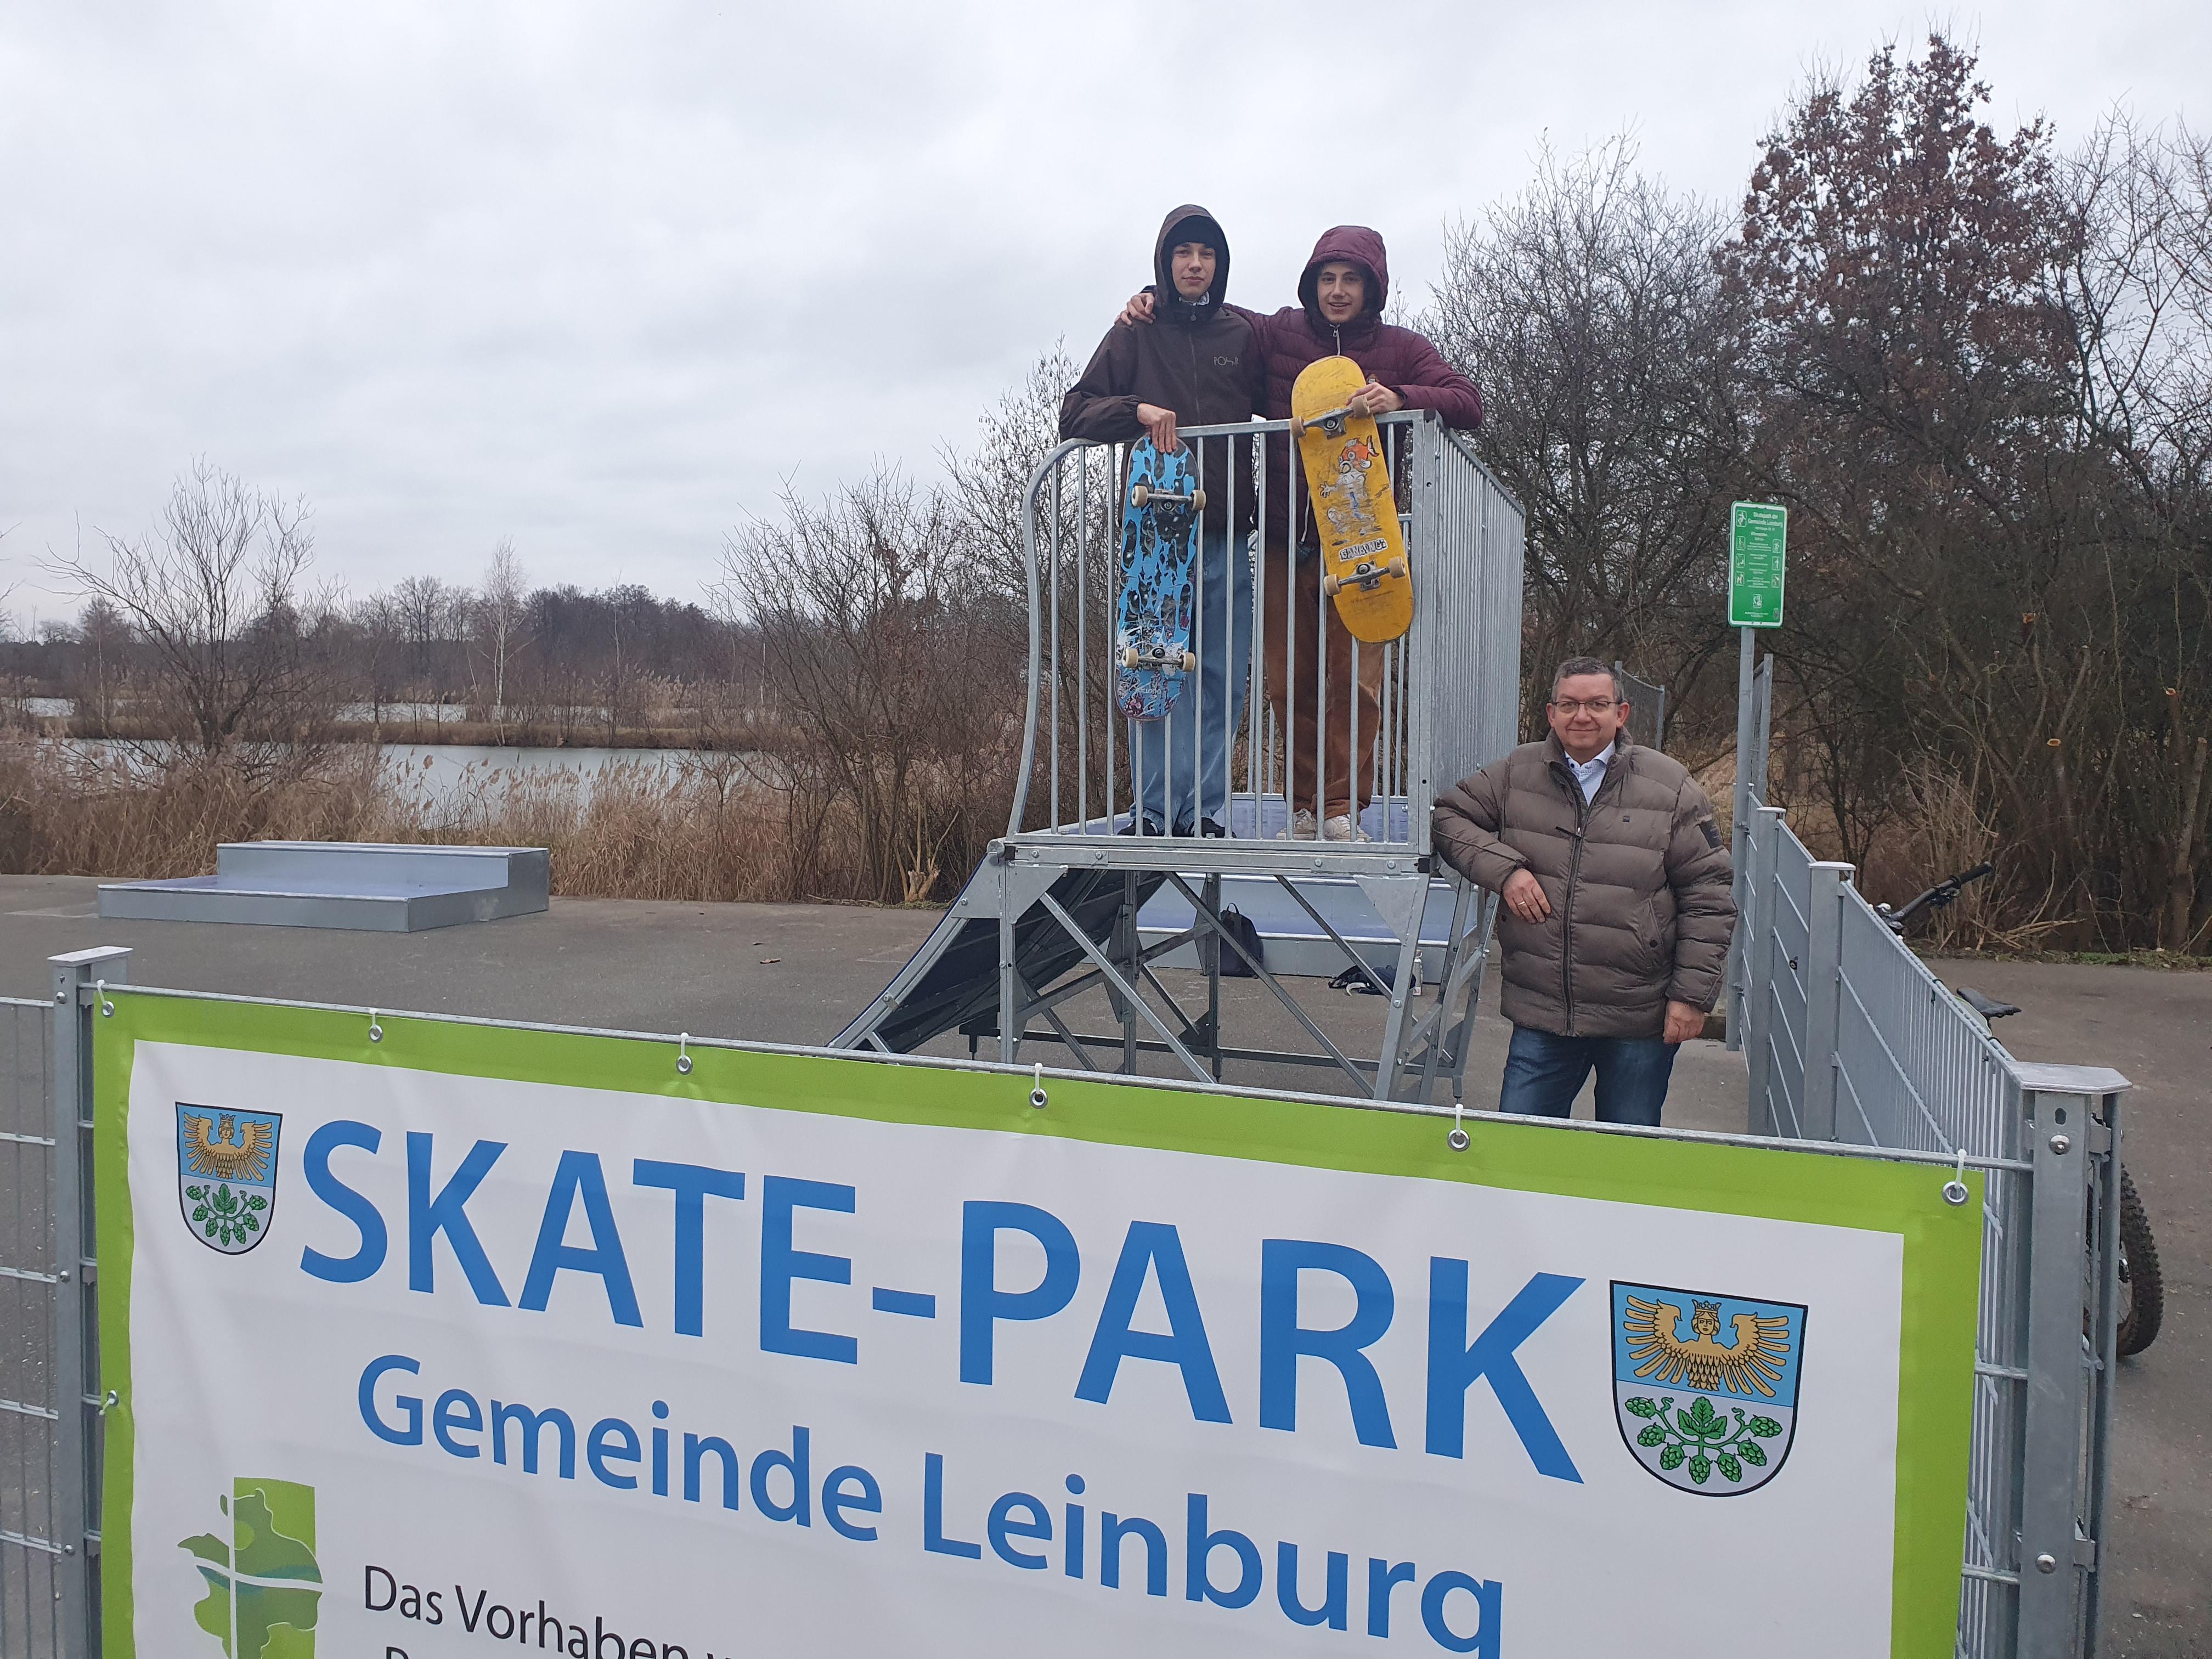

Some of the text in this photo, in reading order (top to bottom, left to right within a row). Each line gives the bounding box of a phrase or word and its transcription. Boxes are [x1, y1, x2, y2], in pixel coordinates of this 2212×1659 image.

[300, 1120, 1585, 1484] SKATE-PARK
[358, 1355, 1502, 1659] Gemeinde Leinburg
[365, 1565, 443, 1625] Das
